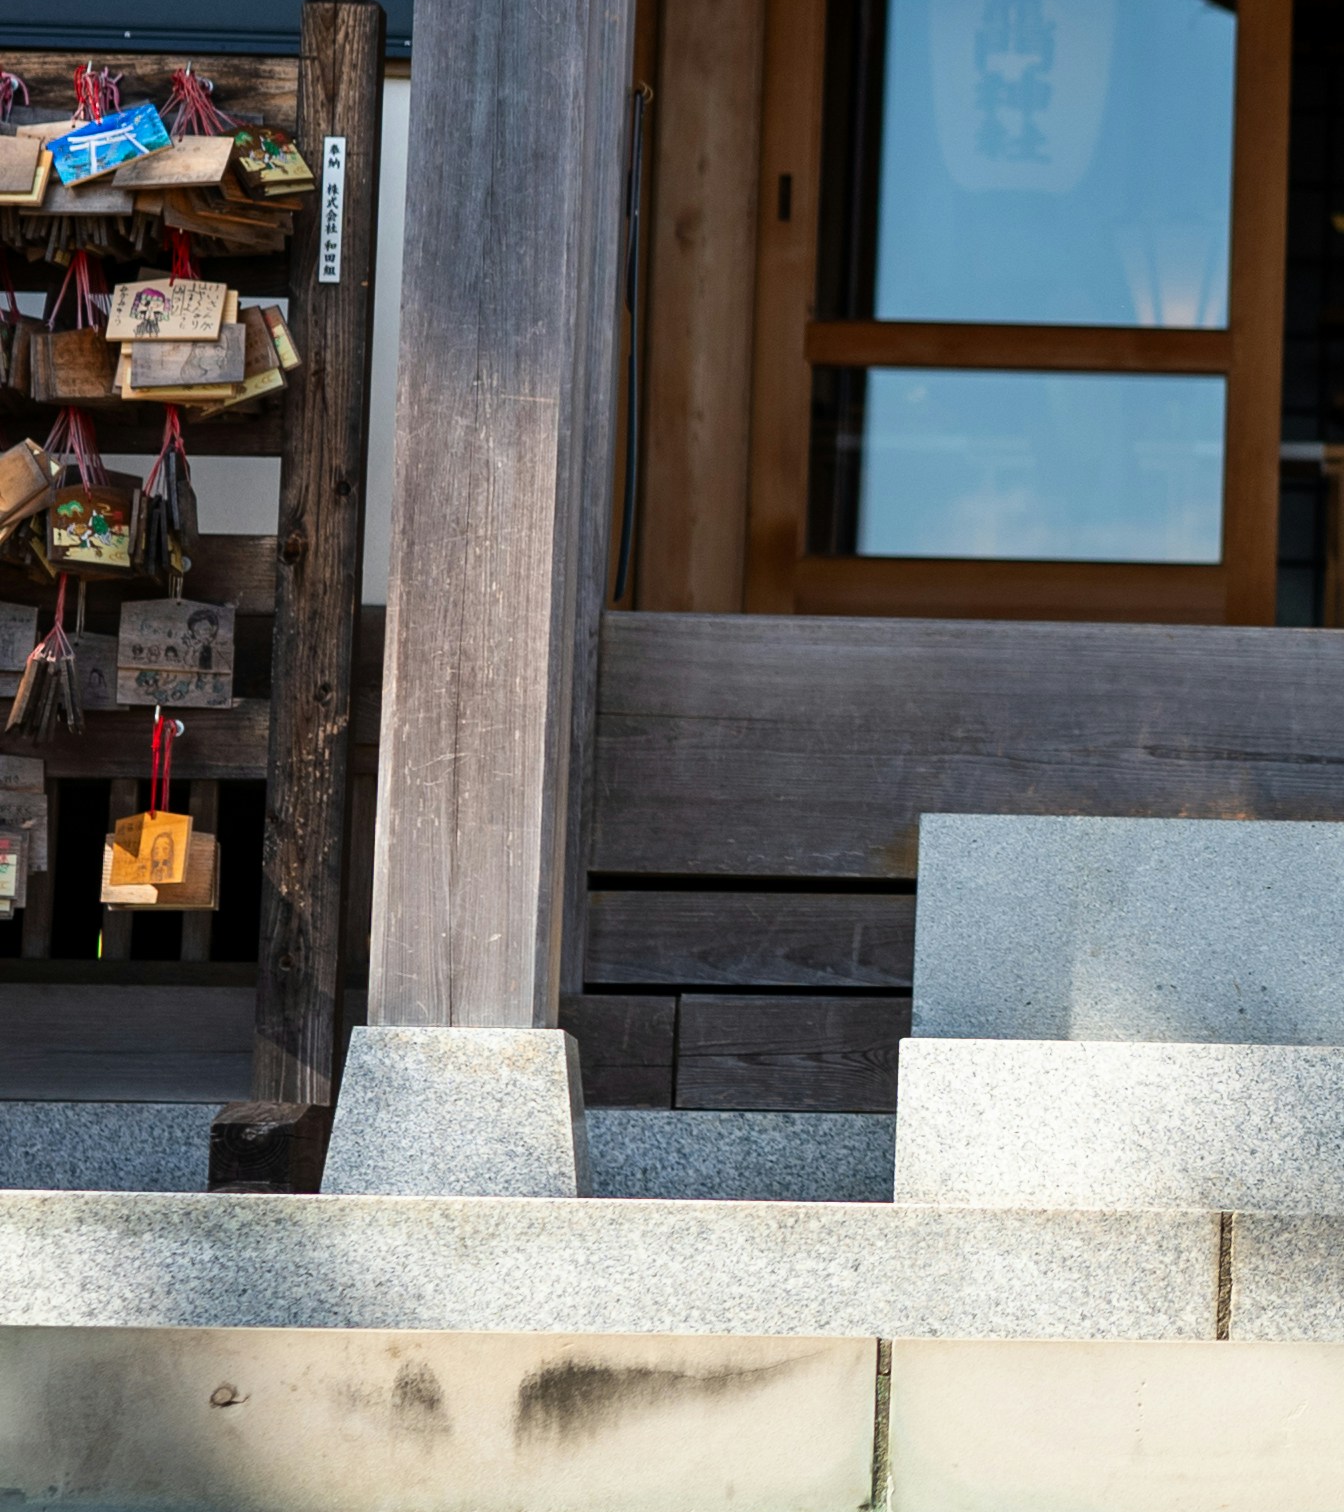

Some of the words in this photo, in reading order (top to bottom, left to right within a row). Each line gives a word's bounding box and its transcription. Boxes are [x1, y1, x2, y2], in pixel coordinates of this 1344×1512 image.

[328, 144, 340, 169] 奉納
[325, 183, 339, 234] 株式会社
[323, 239, 337, 276] 和田組
